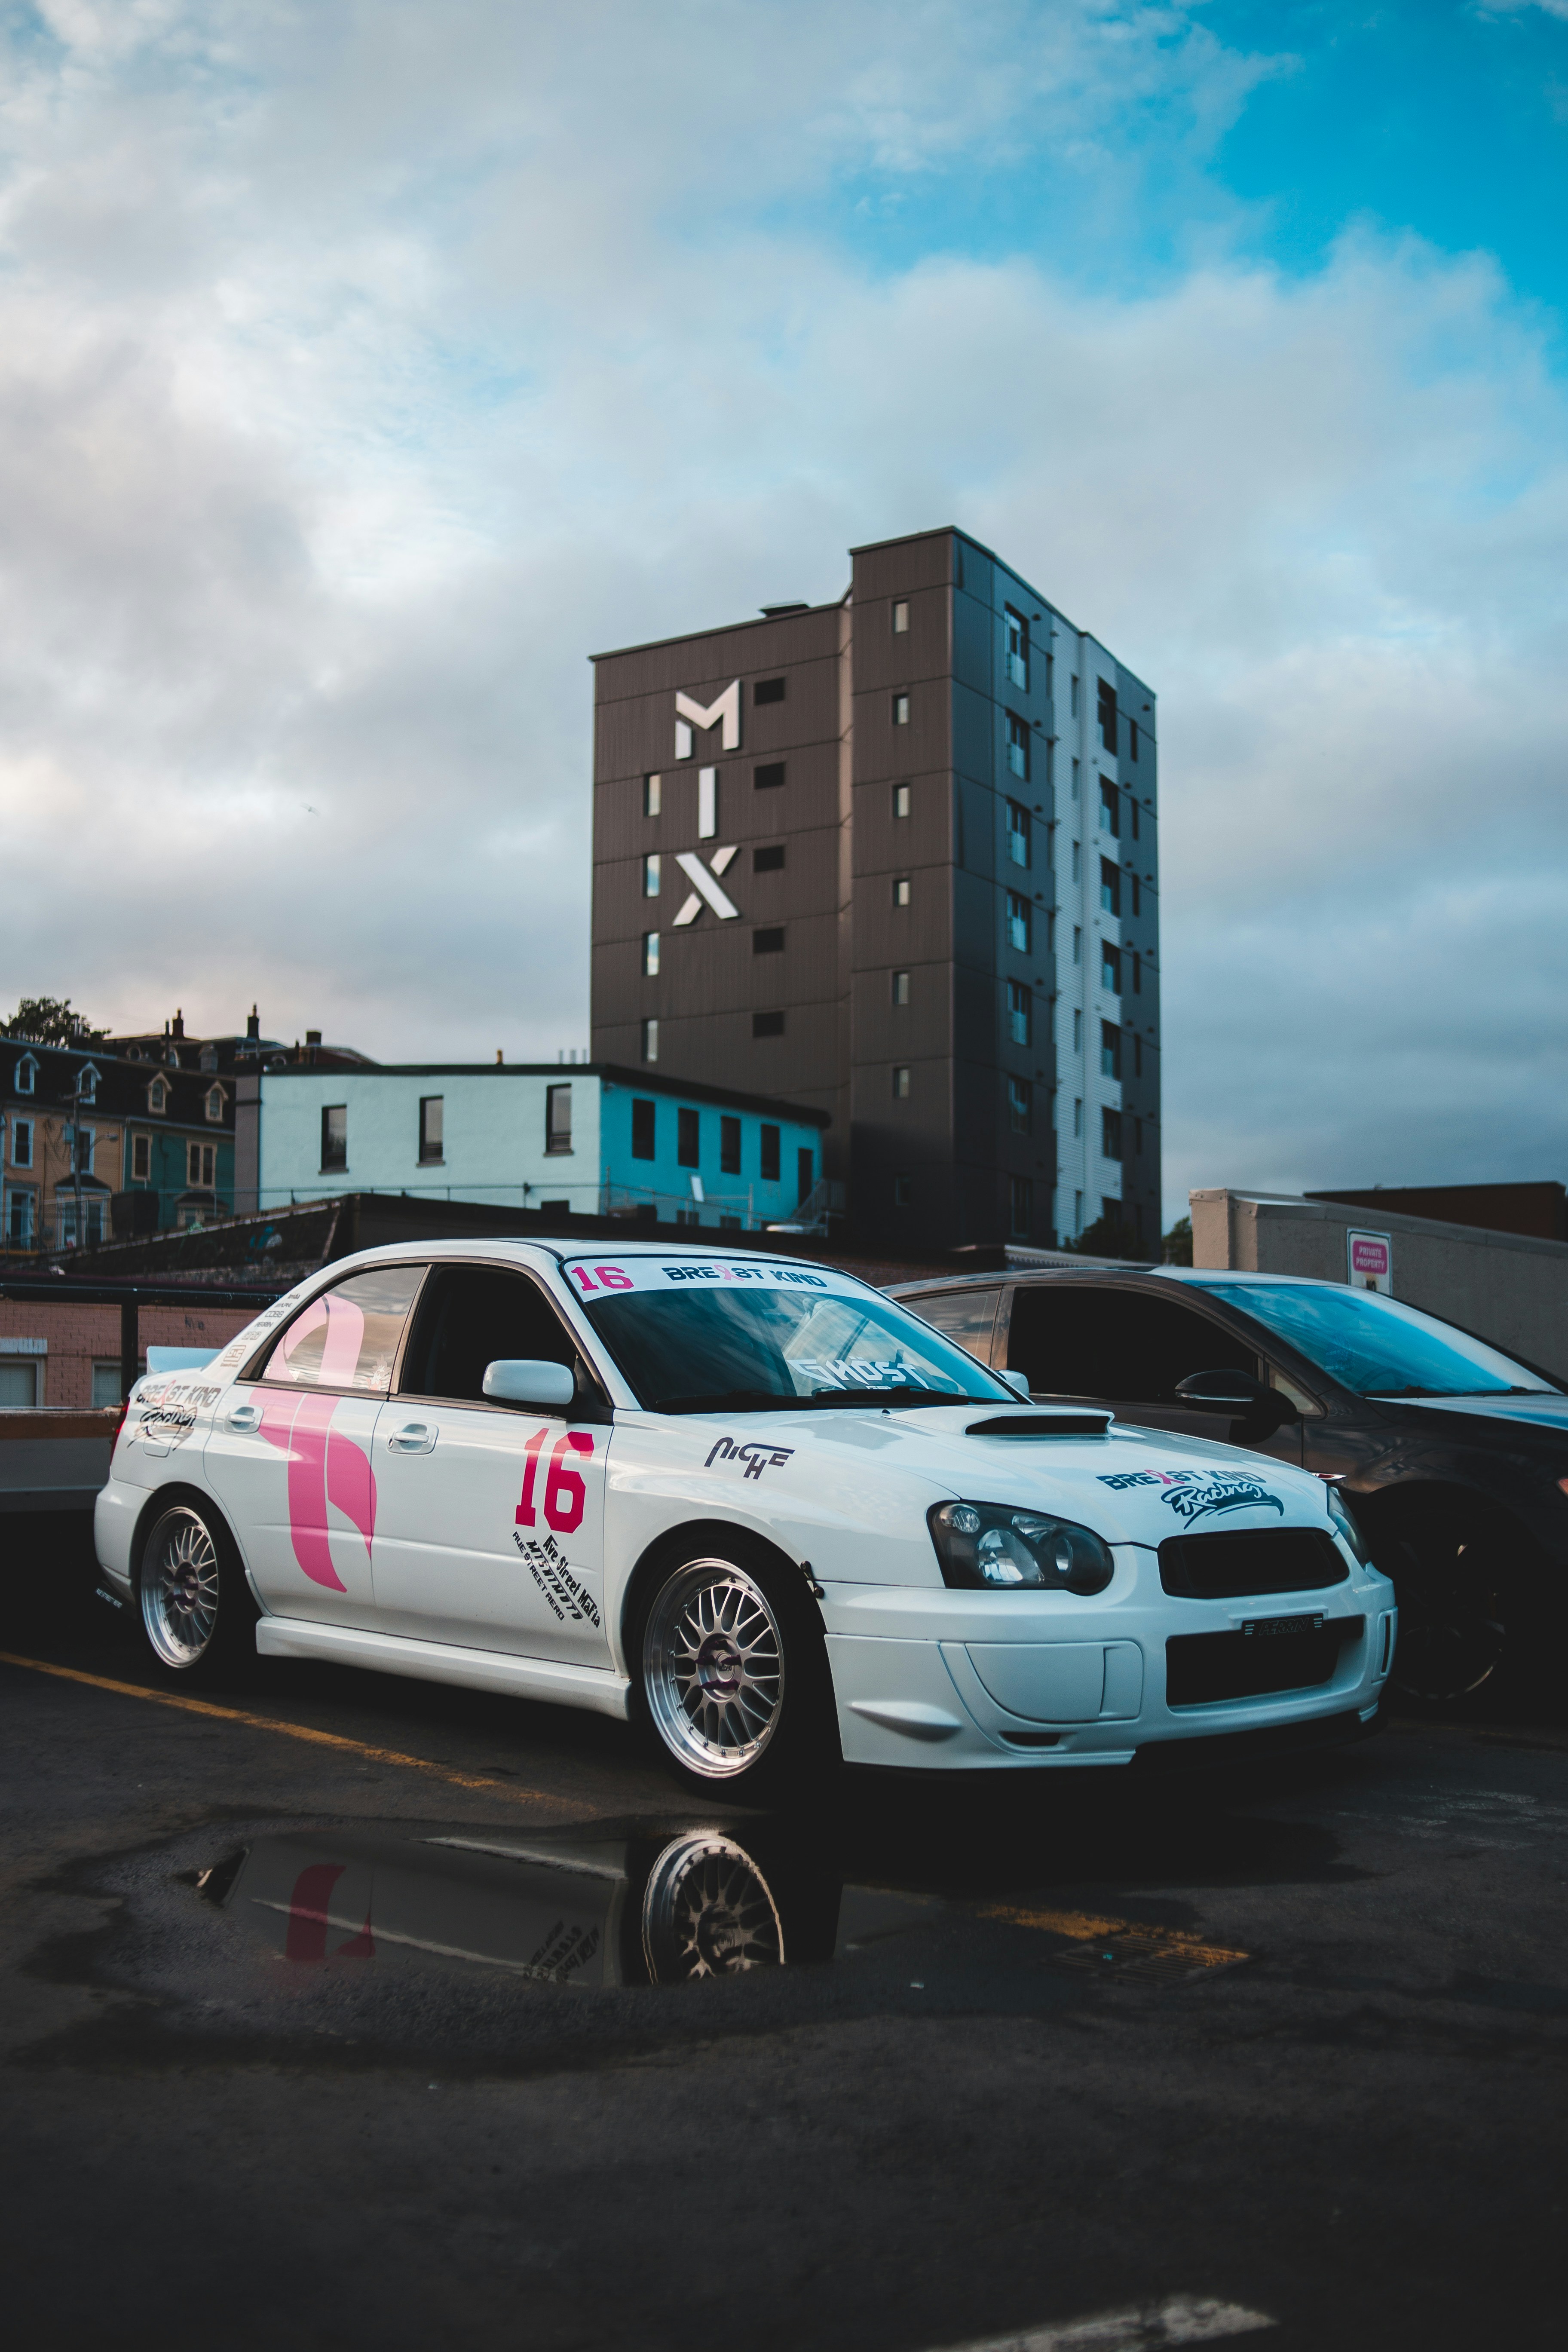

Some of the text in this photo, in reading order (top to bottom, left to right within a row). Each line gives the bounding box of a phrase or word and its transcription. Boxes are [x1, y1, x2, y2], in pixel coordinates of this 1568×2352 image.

[672, 678, 741, 927] MIX
[1356, 1257, 1384, 1270] PROPERTY
[1359, 1246, 1382, 1258] PRIVATE
[570, 1265, 635, 1291] 16
[772, 1270, 827, 1287] KIND
[184, 1385, 221, 1408] KIND
[515, 1427, 594, 1534] 16
[1204, 1470, 1267, 1484] KIND
[1161, 1481, 1273, 1524] Racing
[545, 1592, 565, 1621] AERO
[1259, 1617, 1310, 1636] PERRIN
